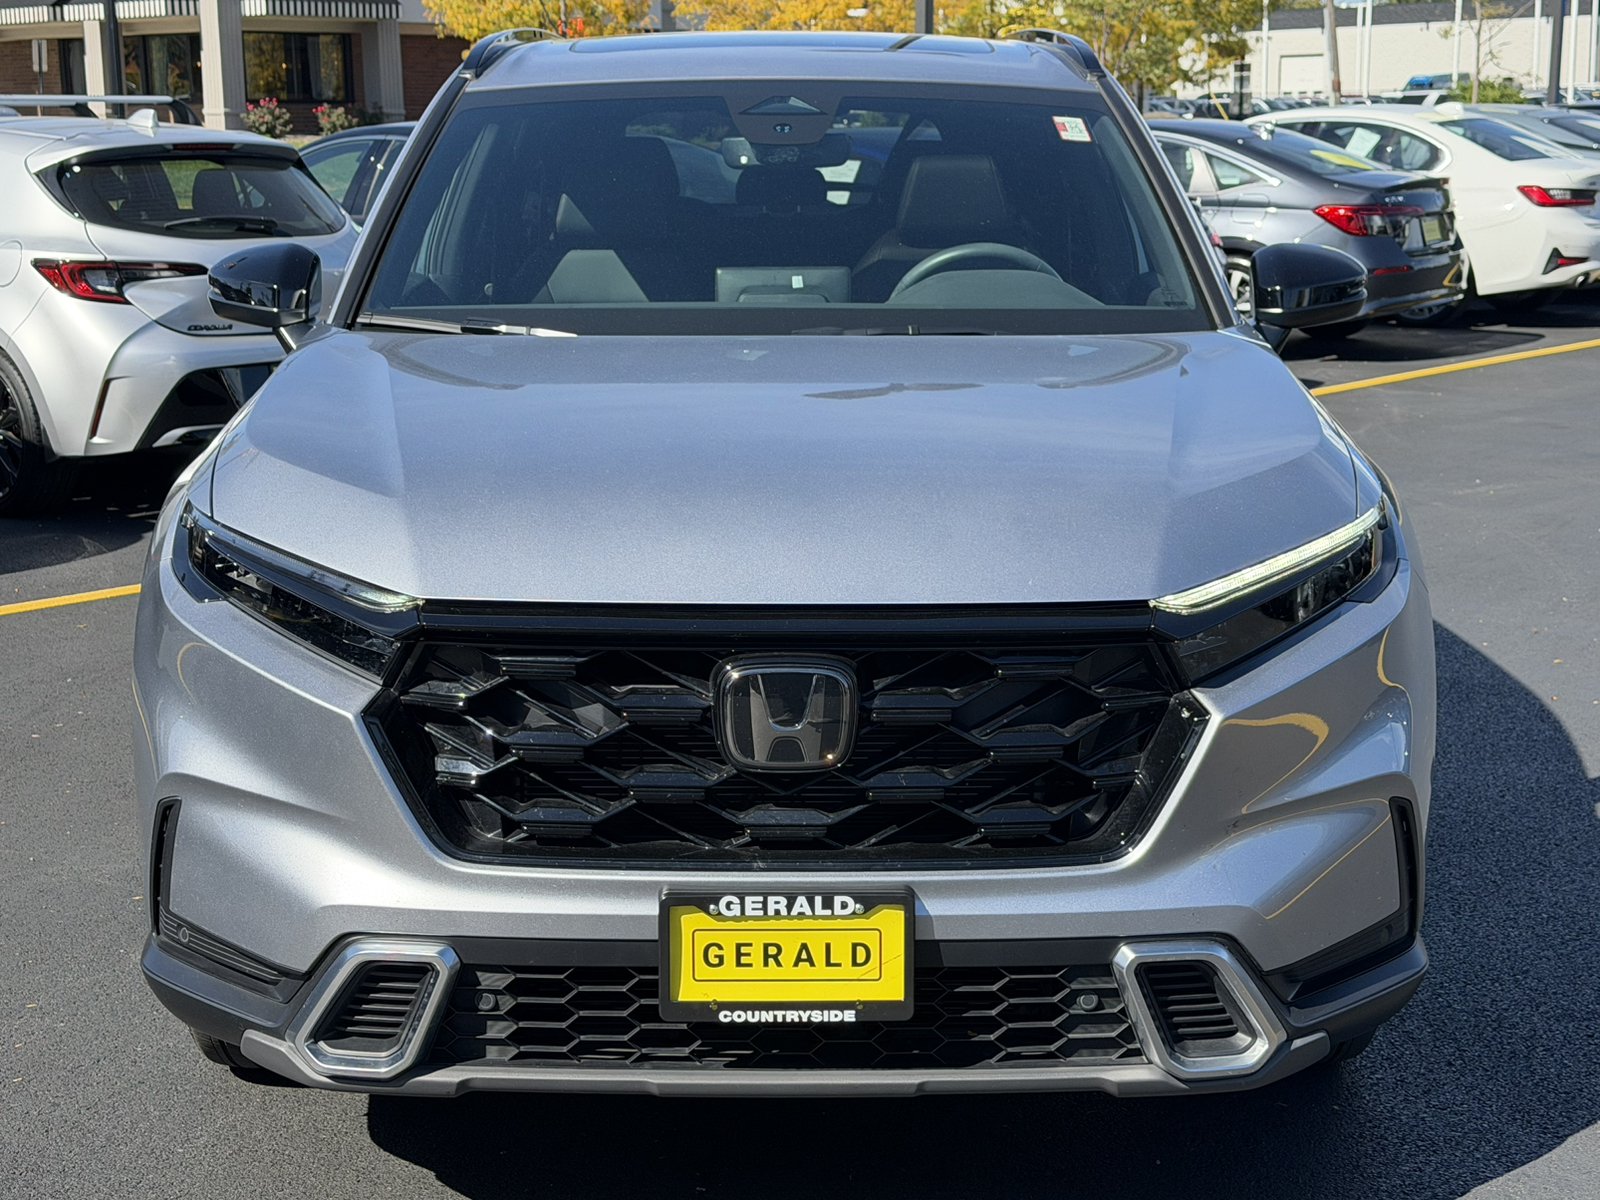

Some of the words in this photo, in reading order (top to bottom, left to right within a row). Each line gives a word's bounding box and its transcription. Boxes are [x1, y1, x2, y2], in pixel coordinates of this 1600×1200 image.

[718, 895, 856, 916] GERALD
[702, 942, 872, 968] GERALD
[718, 1010, 856, 1023] COUNTRYSIDE
